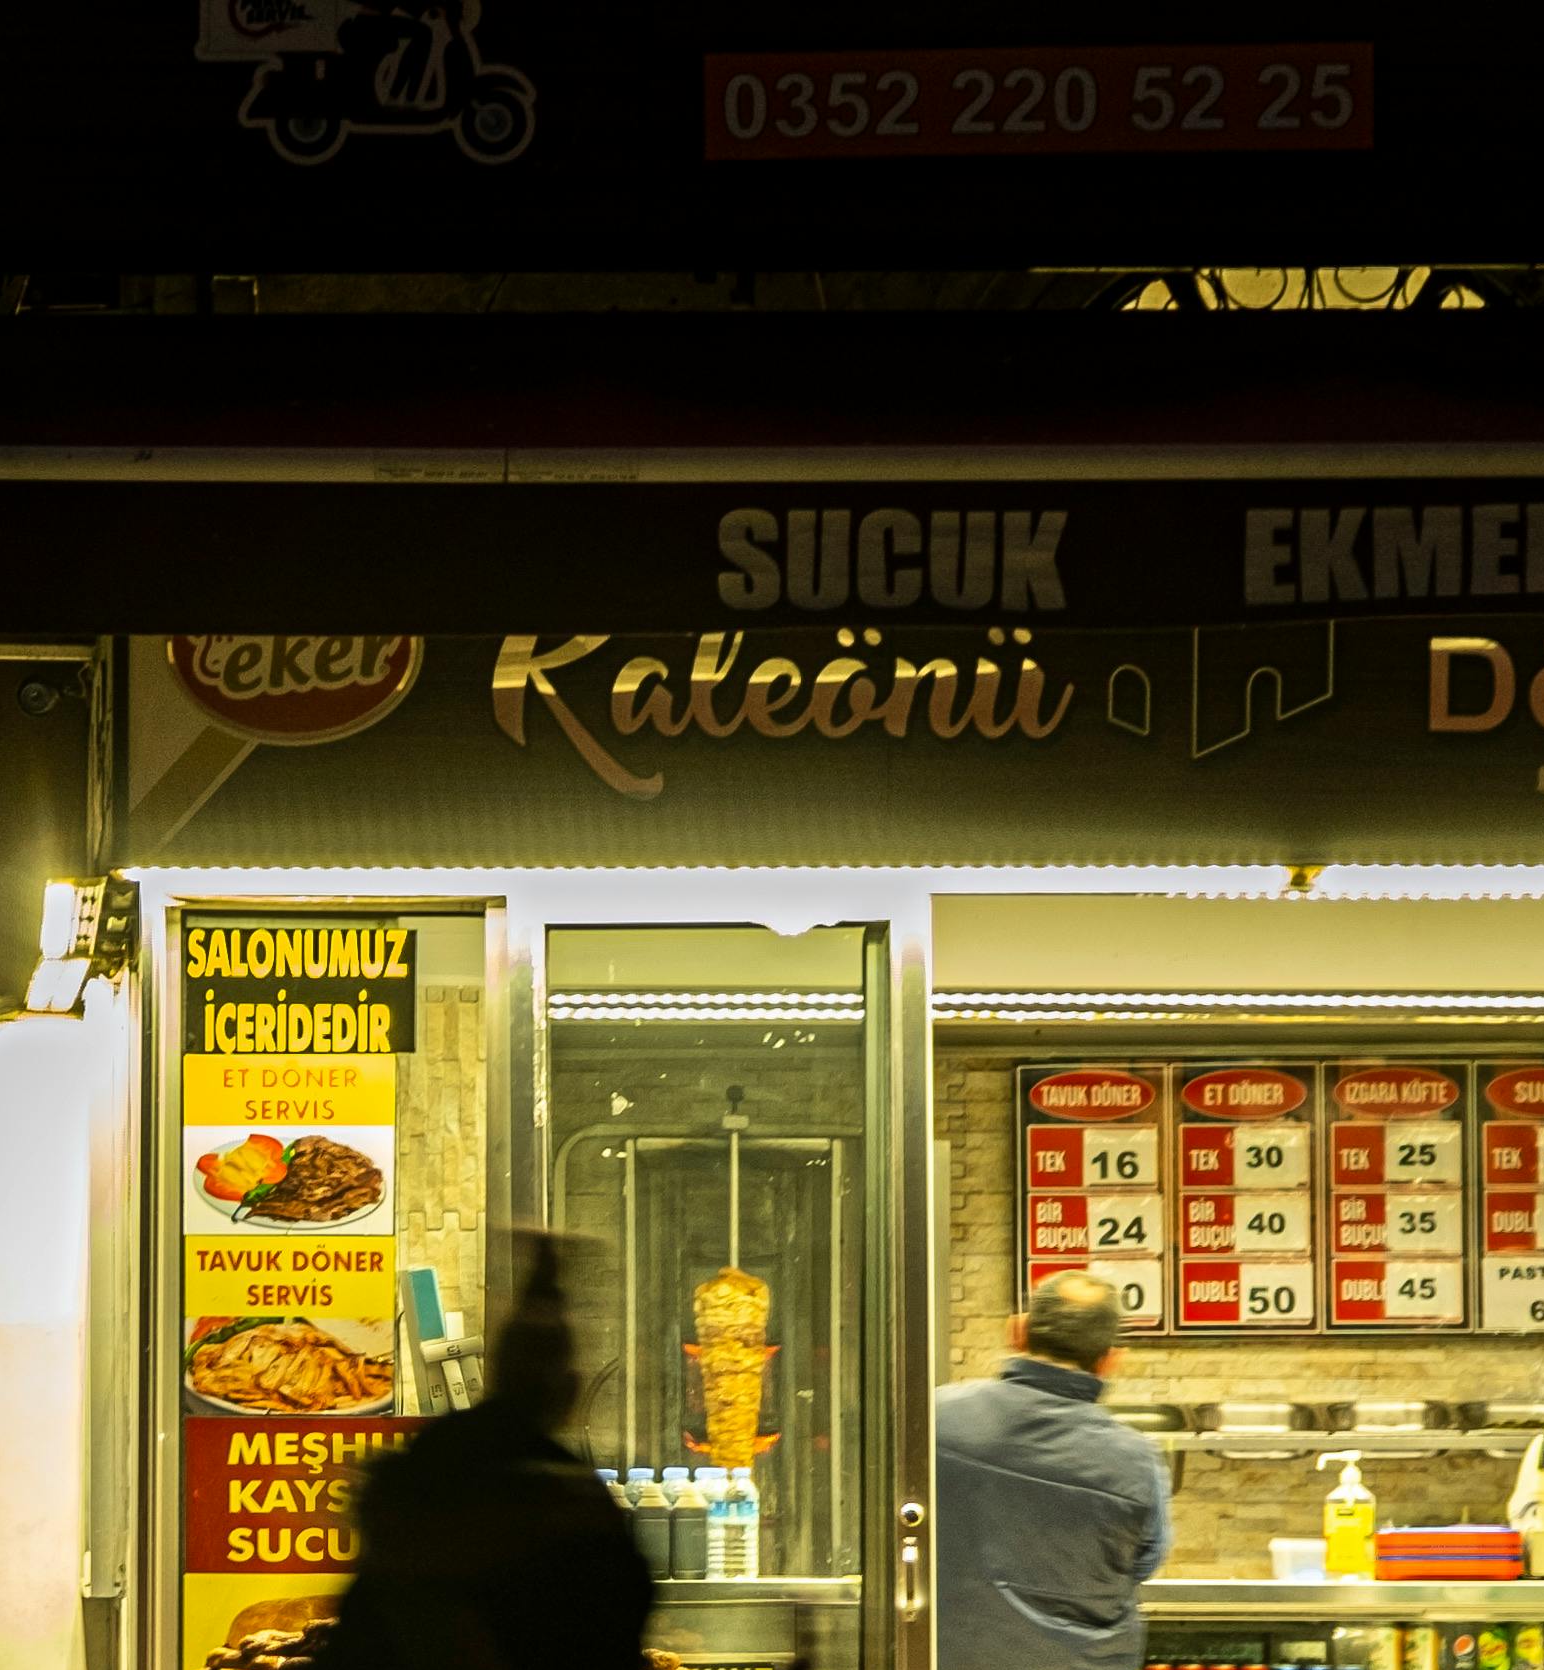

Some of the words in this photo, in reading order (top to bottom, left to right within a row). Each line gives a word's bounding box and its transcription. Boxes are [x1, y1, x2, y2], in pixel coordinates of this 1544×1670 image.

[723, 70, 920, 139] 0352
[951, 66, 1098, 134] 220
[1130, 65, 1226, 131] 52
[1256, 63, 1354, 129] 25
[716, 507, 1069, 613] SUCUK
[490, 626, 1075, 798] Kaleönü
[186, 928, 409, 979] SALONUMUZ
[204, 988, 392, 1056] İÇERİDEDİR
[223, 1069, 250, 1088] ET
[1204, 1084, 1225, 1105] ET
[1228, 1080, 1285, 1105] DÖNER
[1401, 1078, 1448, 1103] KÖFTE
[1040, 1085, 1089, 1107] TAVUK
[1091, 1081, 1142, 1107] DÖNER
[1035, 1151, 1067, 1173] TEK
[1092, 1151, 1139, 1180] 16
[1188, 1149, 1220, 1172] TEK
[1245, 1145, 1284, 1169] 30
[1339, 1147, 1371, 1171] TEK
[1397, 1143, 1437, 1167] 25
[1492, 1146, 1522, 1169] TEK
[1035, 1198, 1063, 1224] BİR
[1188, 1197, 1216, 1223] BİR
[1339, 1196, 1367, 1221] BİR
[1492, 1211, 1536, 1233] DUBL
[1035, 1226, 1089, 1253] BUÇUK
[1097, 1216, 1147, 1247] 24
[1247, 1212, 1286, 1235] 40
[1339, 1225, 1387, 1250] BUÇU
[1398, 1210, 1437, 1234] 35
[196, 1250, 282, 1273] TAVUK
[292, 1244, 385, 1273] DÖNER
[246, 1278, 333, 1306] SERVİS
[1120, 1282, 1145, 1312] 0
[1188, 1280, 1239, 1303] DUBLE
[1248, 1286, 1296, 1315] 50
[1341, 1278, 1387, 1301] DUBL
[1398, 1277, 1437, 1300] 45
[227, 1431, 418, 1474] MEŞHU
[228, 1479, 354, 1514] KAYS
[227, 1527, 360, 1564] SUCU
